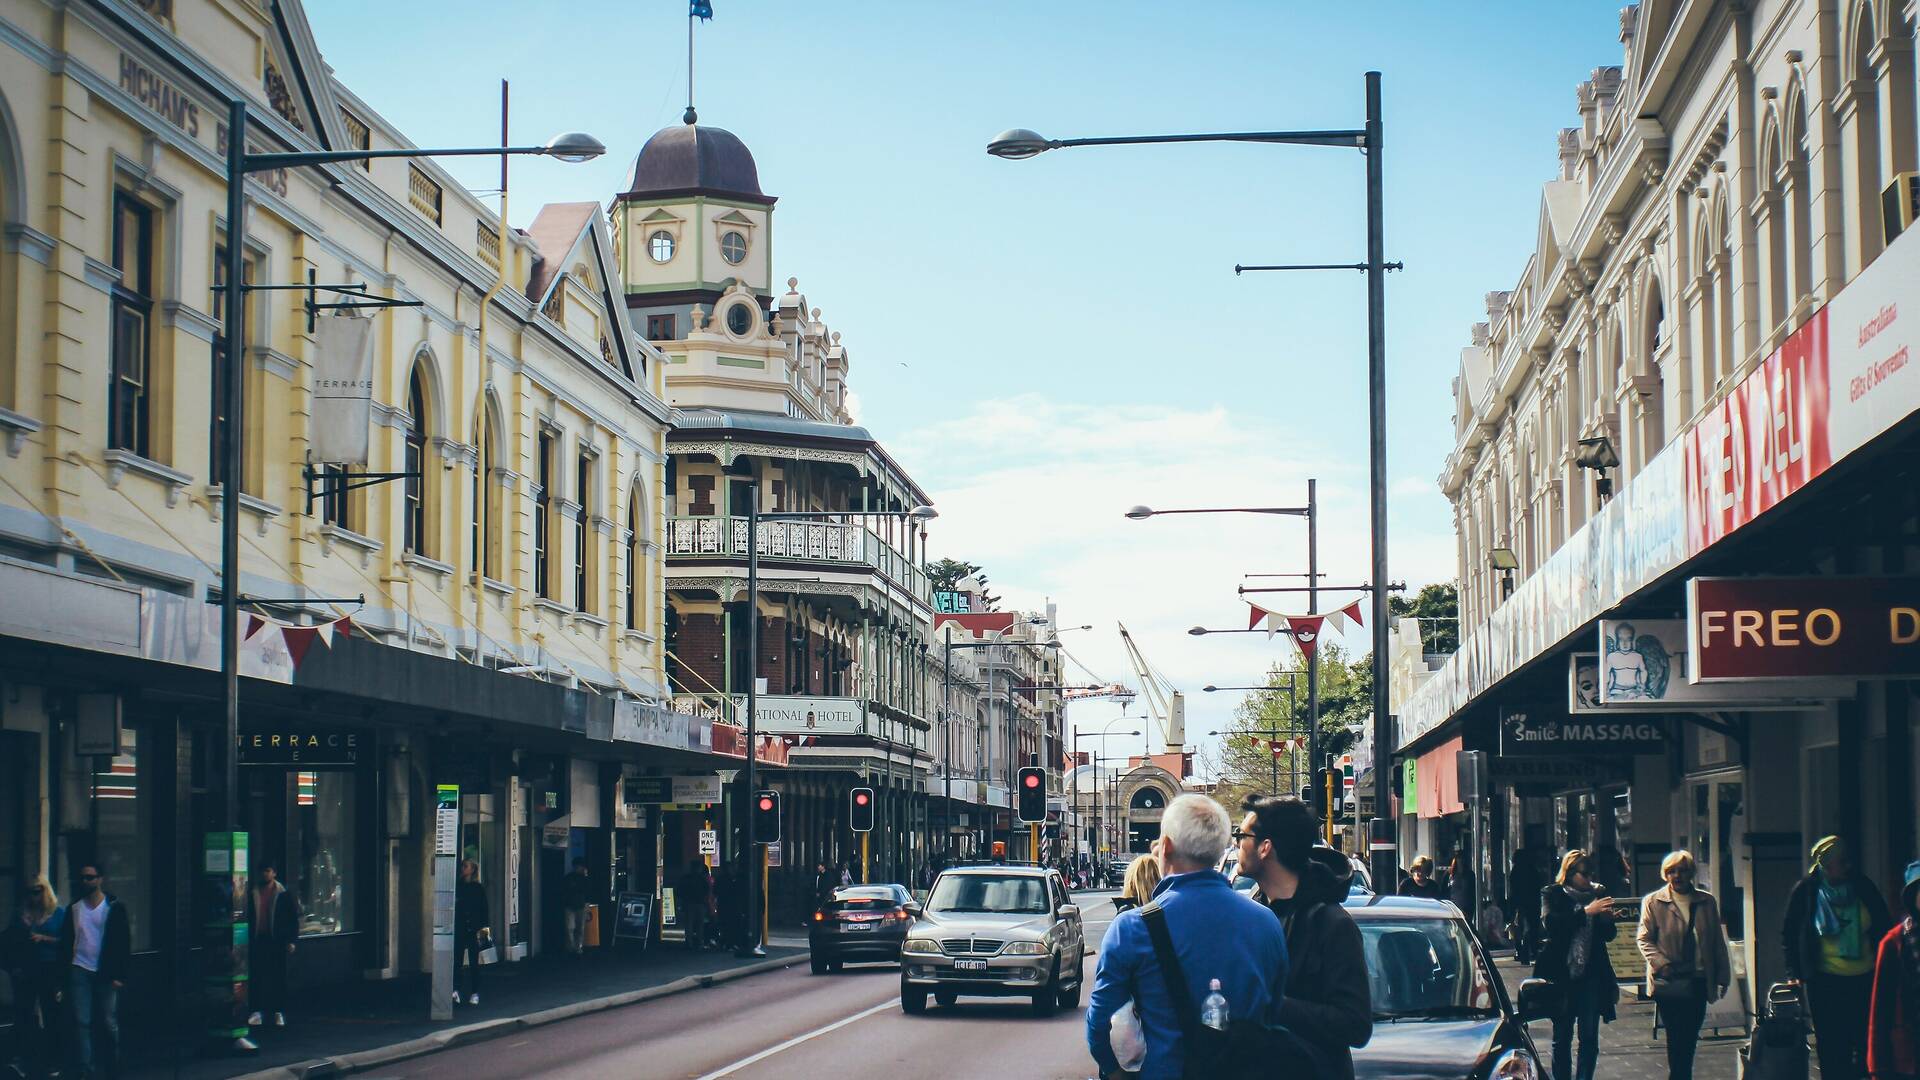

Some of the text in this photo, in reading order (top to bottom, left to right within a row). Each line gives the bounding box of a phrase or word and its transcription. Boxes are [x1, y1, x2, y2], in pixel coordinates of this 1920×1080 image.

[315, 380, 373, 389] TERRACE
[1701, 608, 1841, 648] FREO
[746, 709, 853, 722] ATIONAL HOTEL
[1563, 724, 1662, 741] MASSAGE
[236, 735, 356, 747] TERRACE
